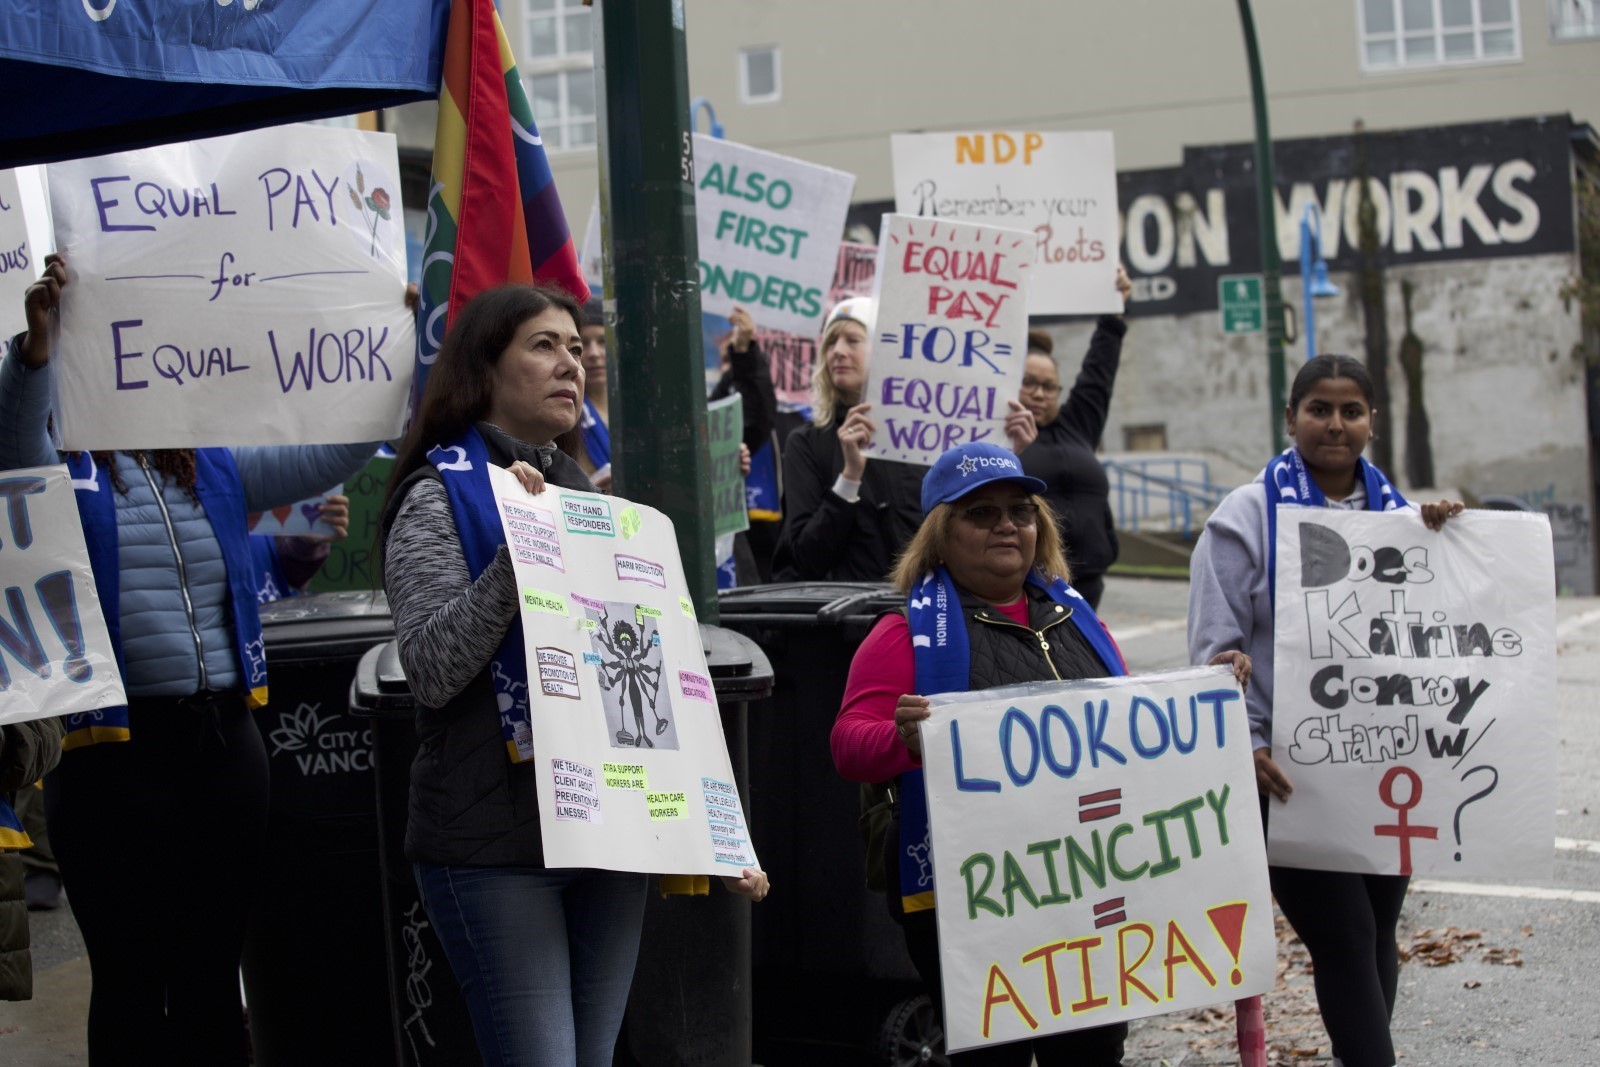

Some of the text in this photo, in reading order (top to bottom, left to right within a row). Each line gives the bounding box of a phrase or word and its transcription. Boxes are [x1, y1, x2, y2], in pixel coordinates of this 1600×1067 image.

[956, 133, 1043, 165] NDP
[699, 161, 792, 210] ALSO
[90, 167, 340, 232] EQUAL PAY
[912, 179, 1097, 228] Remember your
[1119, 158, 1541, 274] ON WORKS
[715, 210, 808, 261] FIRST
[1033, 224, 1105, 264] Roots
[903, 241, 1017, 289] EQUAL
[209, 252, 256, 302] for
[927, 285, 1009, 328] PAY
[111, 319, 393, 393] EQUAL WORK
[881, 376, 1008, 422] EQUAL
[979, 456, 1018, 471] bcgeu
[1297, 471, 1311, 500] UNION
[514, 507, 536, 520] PROVIDE
[565, 501, 603, 516] FIRST HAND
[508, 519, 556, 539] HOLISTIC SUPPORT
[567, 515, 611, 531] RESPONDERS
[512, 533, 561, 556] TO THE WOMEN AND
[1298, 521, 1435, 588] Does
[516, 548, 554, 565] THEIR FAMILIES
[617, 560, 664, 578] HARM REDUCTION
[524, 594, 564, 612] MENTAL HEALTH
[936, 613, 948, 647] UNION
[1304, 590, 1522, 660] Katrine
[537, 652, 568, 665] WE PROVIDE
[540, 667, 577, 681] PROMOTION OF
[543, 682, 564, 693] HEALTH
[1309, 664, 1490, 725] Conroy
[318, 731, 358, 749] CITY
[1288, 713, 1418, 765] Stand
[553, 760, 593, 778] WE TEACH OUR
[603, 763, 644, 775] ATIRA SUPPORT
[554, 775, 593, 792] CLIENT ABOUT
[606, 779, 645, 789] WORKERS ARE
[556, 790, 599, 808] PREVENTION OF
[646, 792, 685, 803] HEALTH CARE
[557, 806, 588, 820] ILNESSES
[649, 808, 679, 818] WORKERS
[960, 783, 1231, 920] RAINCITY
[982, 902, 1248, 1038] ATIRA!
